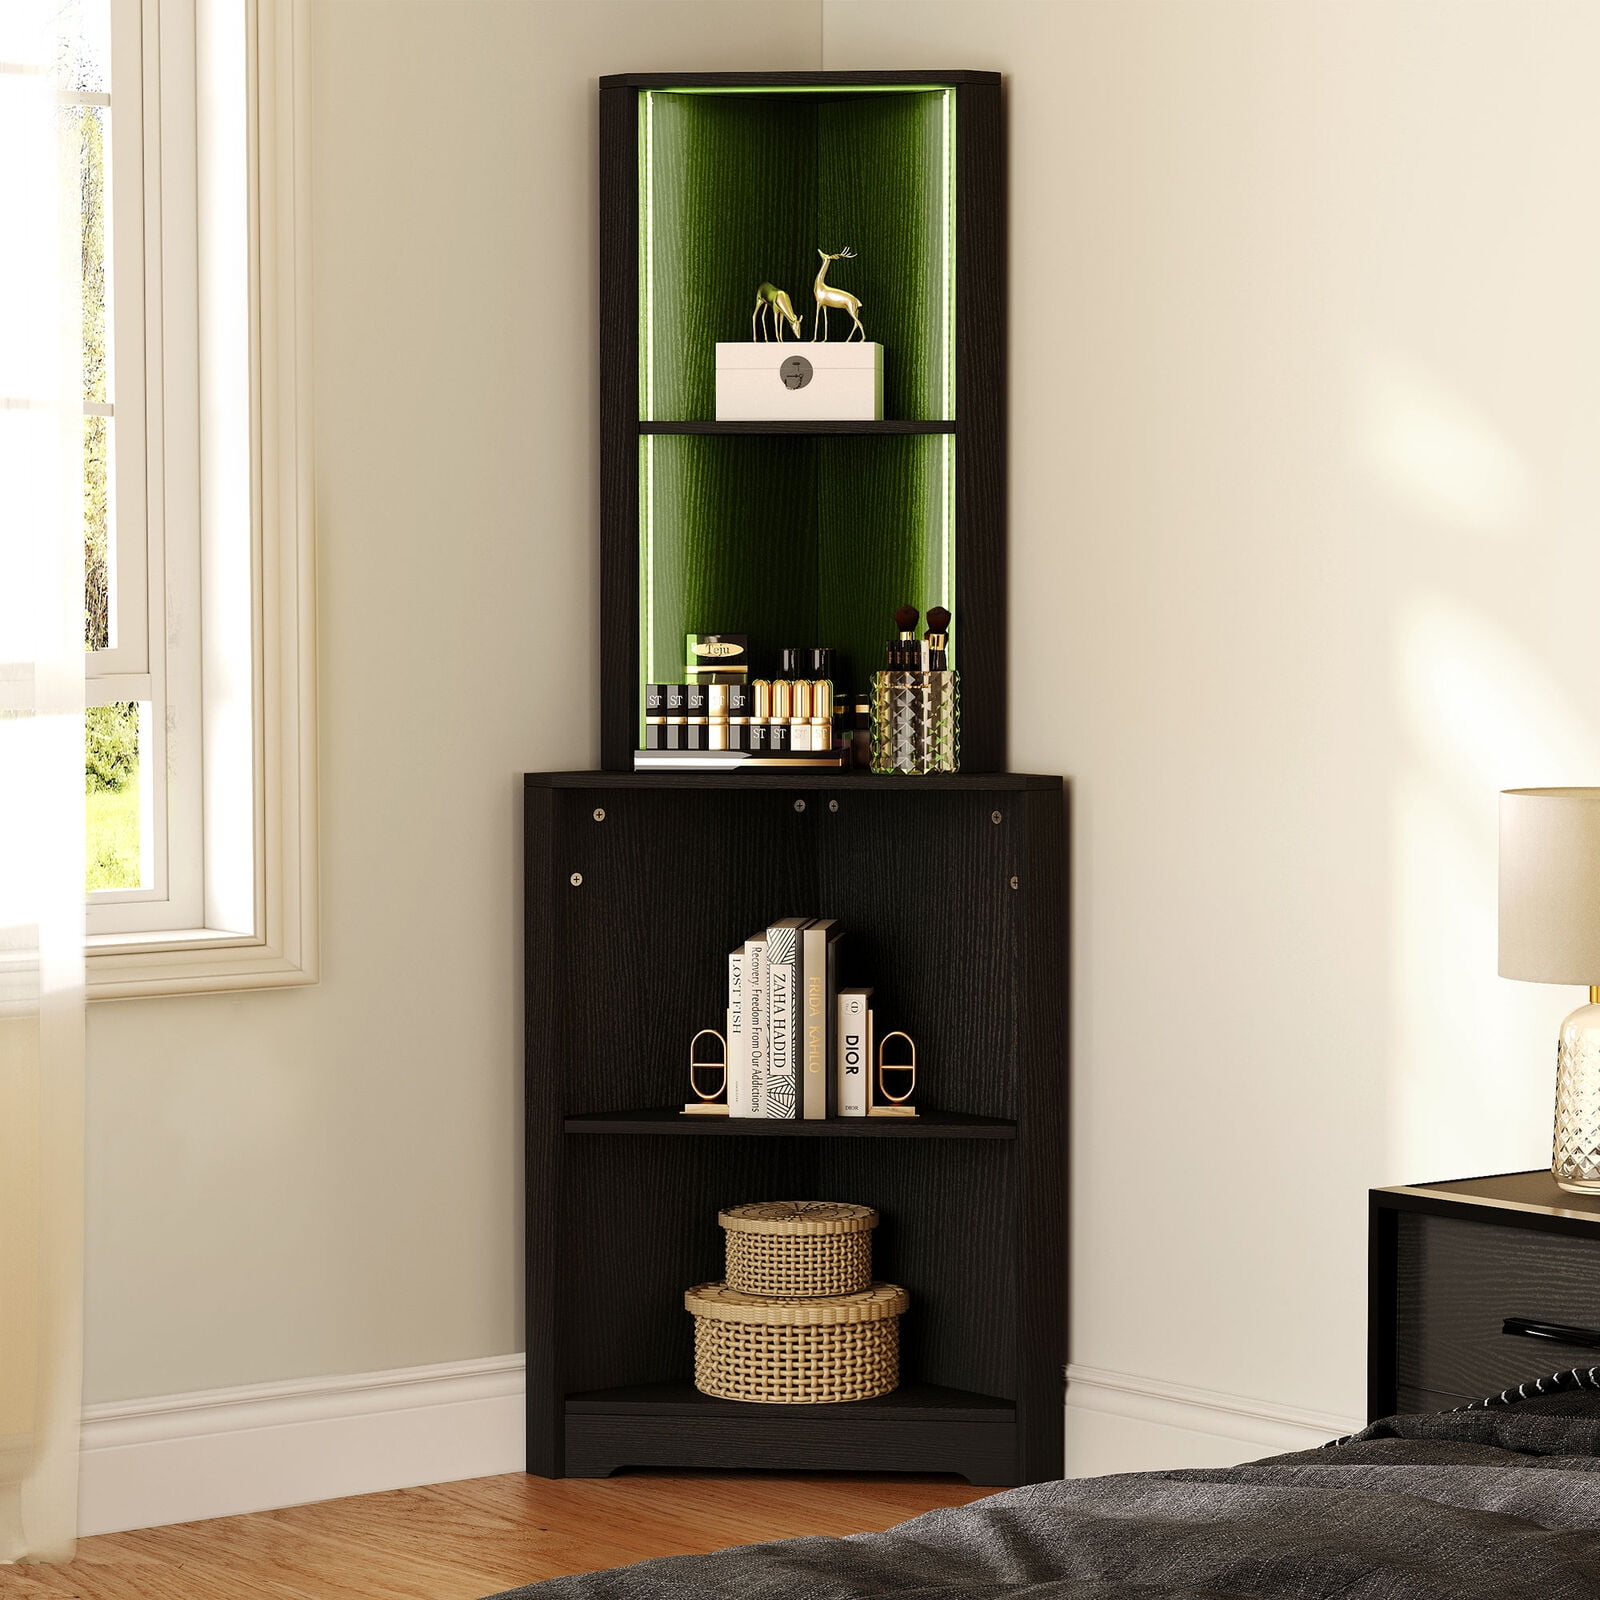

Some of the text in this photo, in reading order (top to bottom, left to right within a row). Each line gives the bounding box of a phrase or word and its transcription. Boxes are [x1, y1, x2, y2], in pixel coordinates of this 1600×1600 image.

[706, 643, 730, 657] Teju
[649, 695, 662, 706] ST
[670, 695, 683, 706] ST
[690, 695, 704, 706] ST
[732, 695, 746, 706] ST
[753, 728, 766, 739] ST
[773, 728, 786, 739] ST
[732, 958, 741, 1034] LOST FISH
[751, 989, 763, 1026] Freedom
[773, 973, 786, 1068] ZAHA HADID
[809, 976, 821, 1073] FRIDA KAHLO
[751, 1027, 762, 1049] From
[751, 1051, 762, 1067] Our
[845, 1035, 859, 1075] DIOR
[751, 1069, 763, 1113] Addictions
